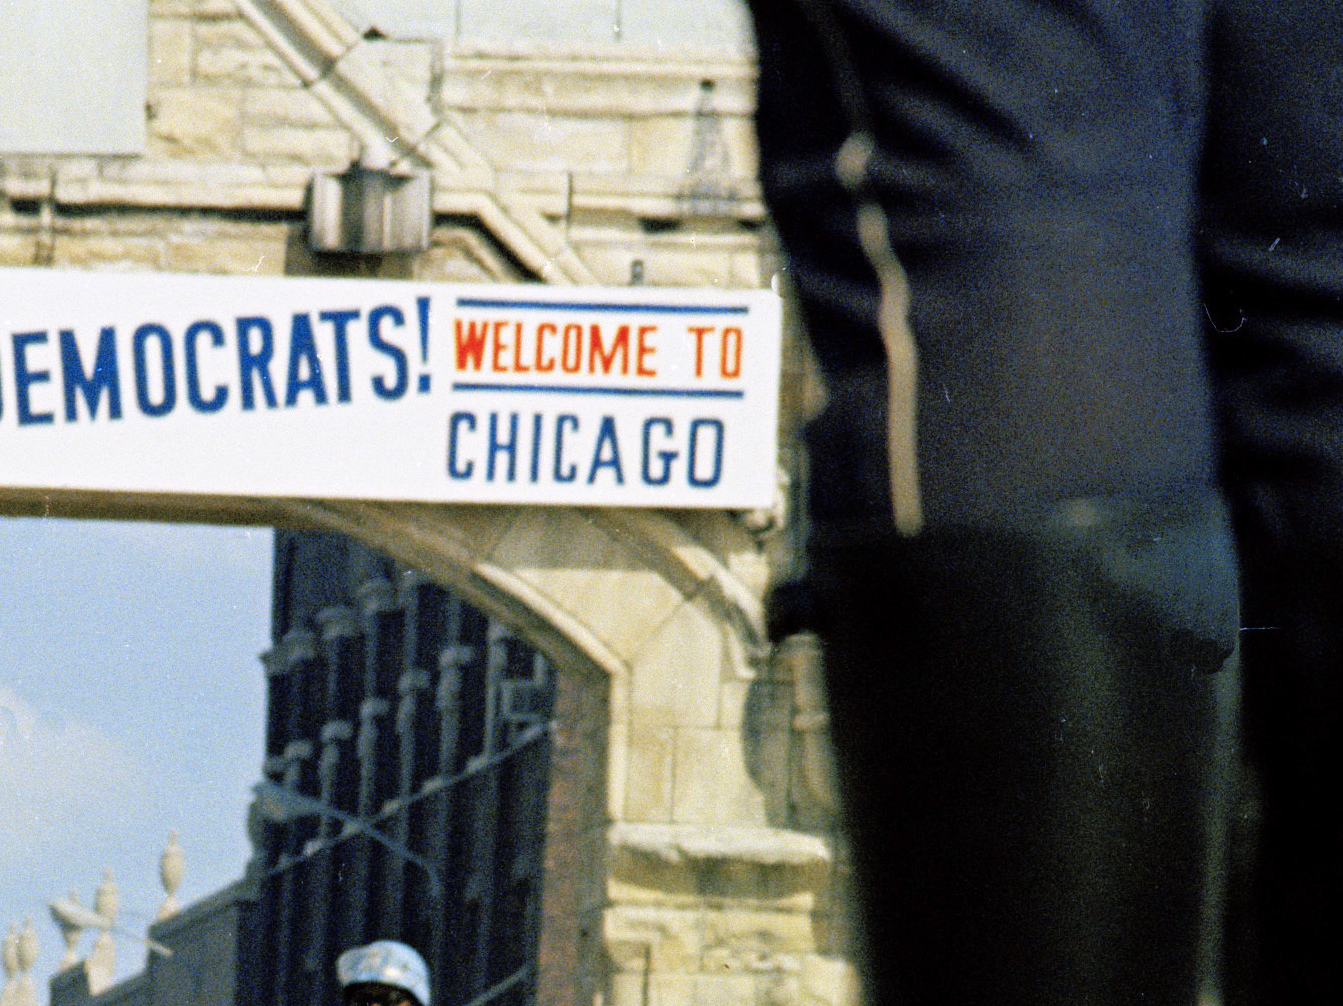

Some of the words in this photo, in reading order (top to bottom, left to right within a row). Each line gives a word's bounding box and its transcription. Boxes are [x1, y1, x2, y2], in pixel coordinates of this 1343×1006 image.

[453, 319, 658, 378] WELCOME
[687, 326, 743, 380] TO
[447, 411, 725, 489] CHICAGO
